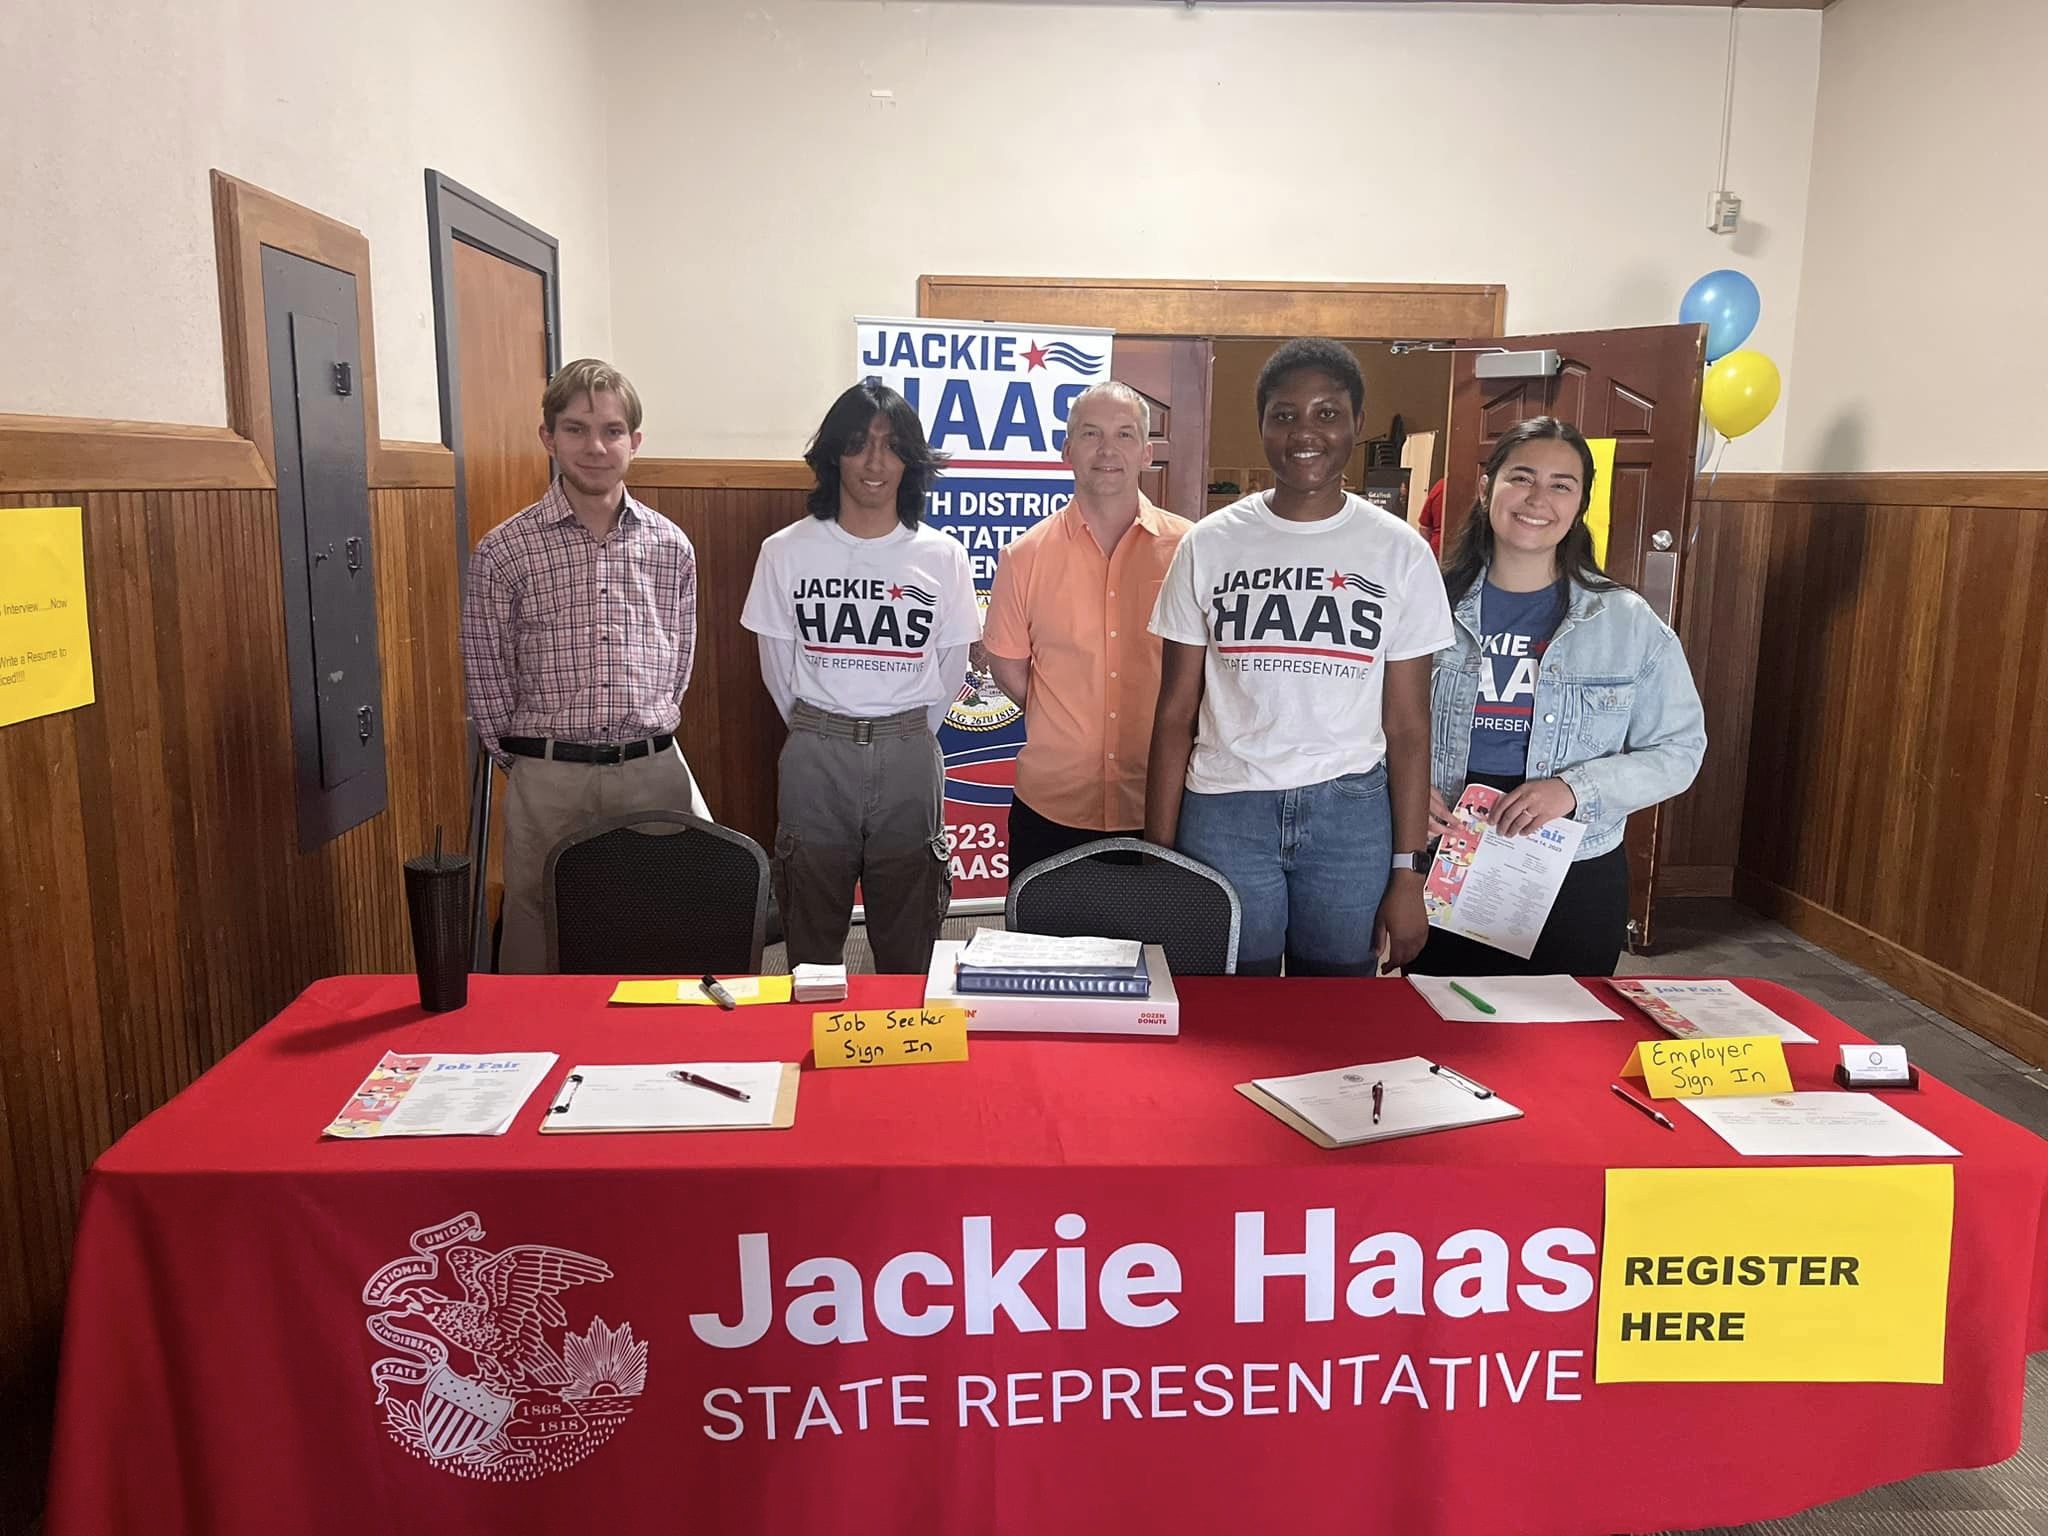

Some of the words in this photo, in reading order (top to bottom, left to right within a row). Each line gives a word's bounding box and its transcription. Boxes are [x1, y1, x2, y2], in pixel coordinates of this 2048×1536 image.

[863, 331, 1016, 372] JACKIE
[866, 375, 1093, 452] AA
[925, 491, 951, 515] H
[960, 492, 1074, 517] DISTRIC
[793, 578, 885, 600] JACKIE
[1213, 567, 1325, 595] JACKIE
[795, 602, 934, 648] HAAS
[1212, 593, 1383, 650] HAAS
[27, 651, 58, 663] Resume
[59, 648, 67, 657] to
[805, 655, 829, 669] STATE
[832, 658, 925, 673] REPRESENTATIVE
[1253, 659, 1369, 681] REPRESENTATIE
[1540, 829, 1566, 844] air
[826, 1013, 866, 1032] Job
[844, 1040, 884, 1063] Sign
[903, 1040, 933, 1053] In
[1653, 1042, 1753, 1068] Employer
[433, 1063, 472, 1071] Job
[477, 1061, 520, 1069] Fair
[1671, 1067, 1714, 1095] Sign
[1730, 1068, 1766, 1083] In
[424, 1220, 469, 1244] UNION
[370, 1263, 427, 1298] NATIONAL
[689, 1213, 1182, 1348] Jackie
[1234, 1208, 1597, 1324] Haas
[1624, 1255, 1860, 1286] REGISTER
[1620, 1312, 1745, 1341] HERE
[382, 1364, 418, 1379] STATE
[702, 1375, 930, 1441] STATE
[957, 1350, 1585, 1428] REPRESENTATIVE
[521, 1404, 562, 1416] 1868
[538, 1420, 579, 1432] 1818
